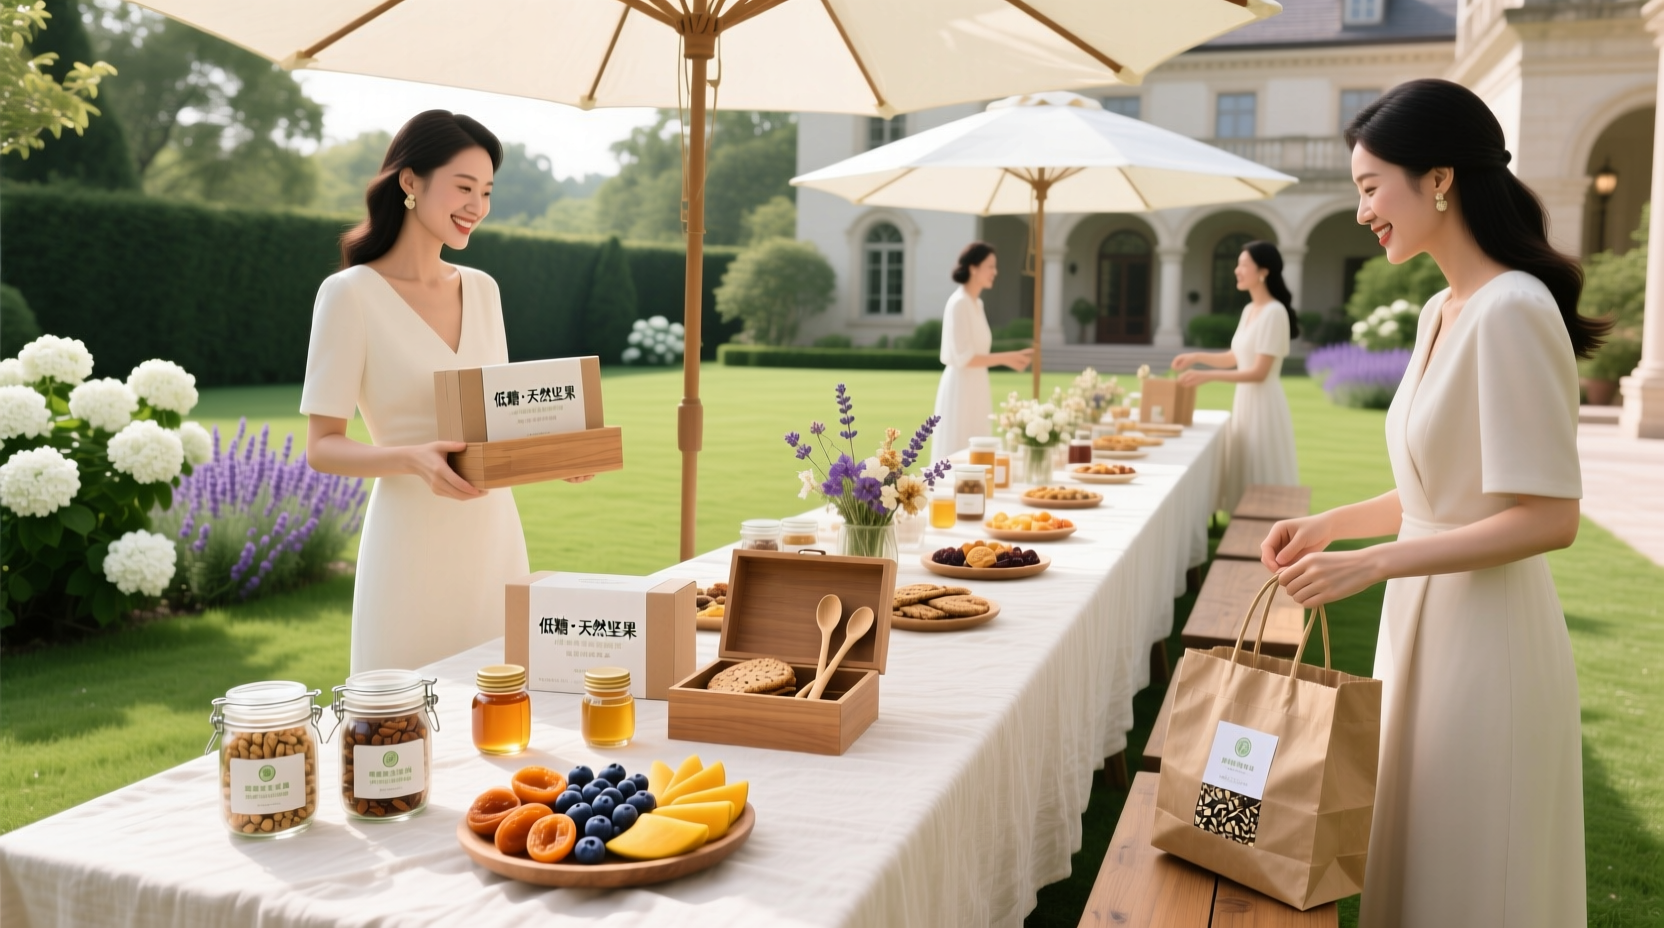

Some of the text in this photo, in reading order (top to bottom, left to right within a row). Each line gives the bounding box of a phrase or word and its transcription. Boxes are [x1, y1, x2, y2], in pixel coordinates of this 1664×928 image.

[539, 616, 637, 640] 低糖·天然坚果
